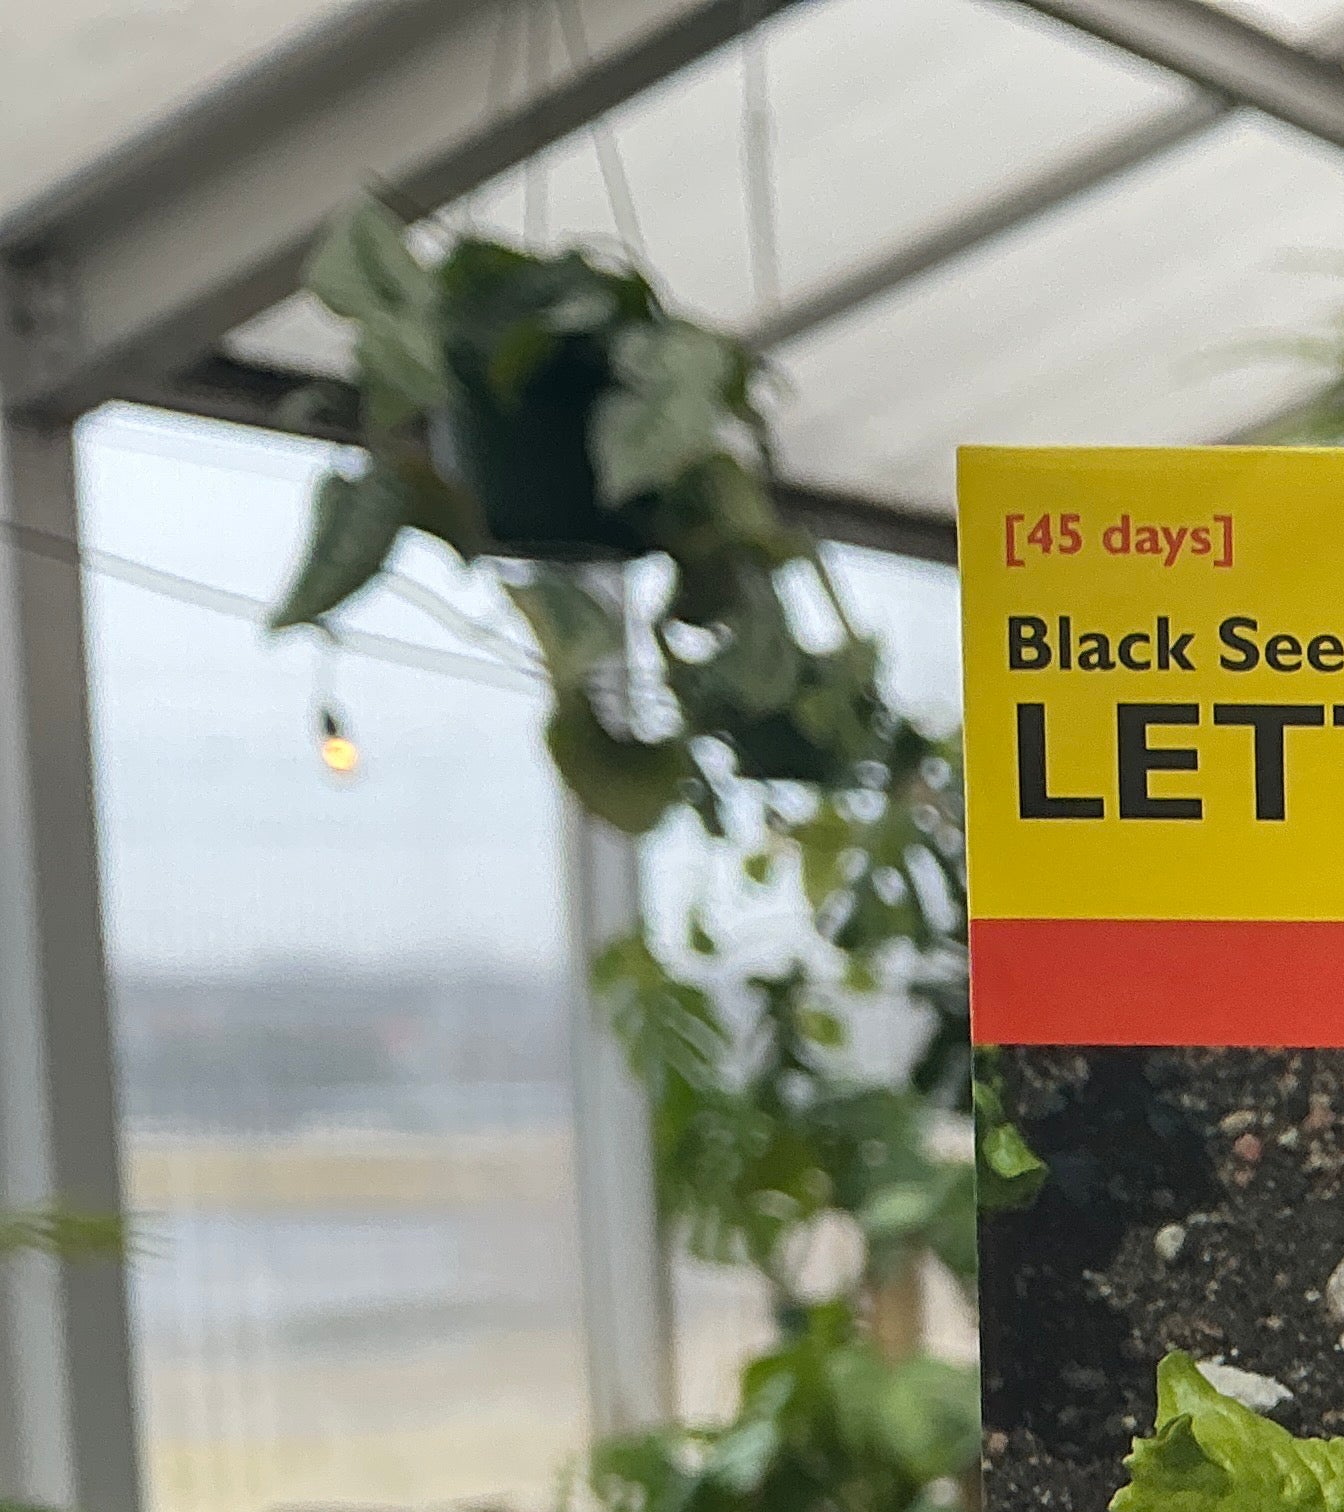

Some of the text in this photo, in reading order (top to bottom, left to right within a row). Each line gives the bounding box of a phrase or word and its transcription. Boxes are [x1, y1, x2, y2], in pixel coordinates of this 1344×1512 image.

[1004, 514, 1235, 568] [45 days]
[1007, 616, 1197, 673] Black
